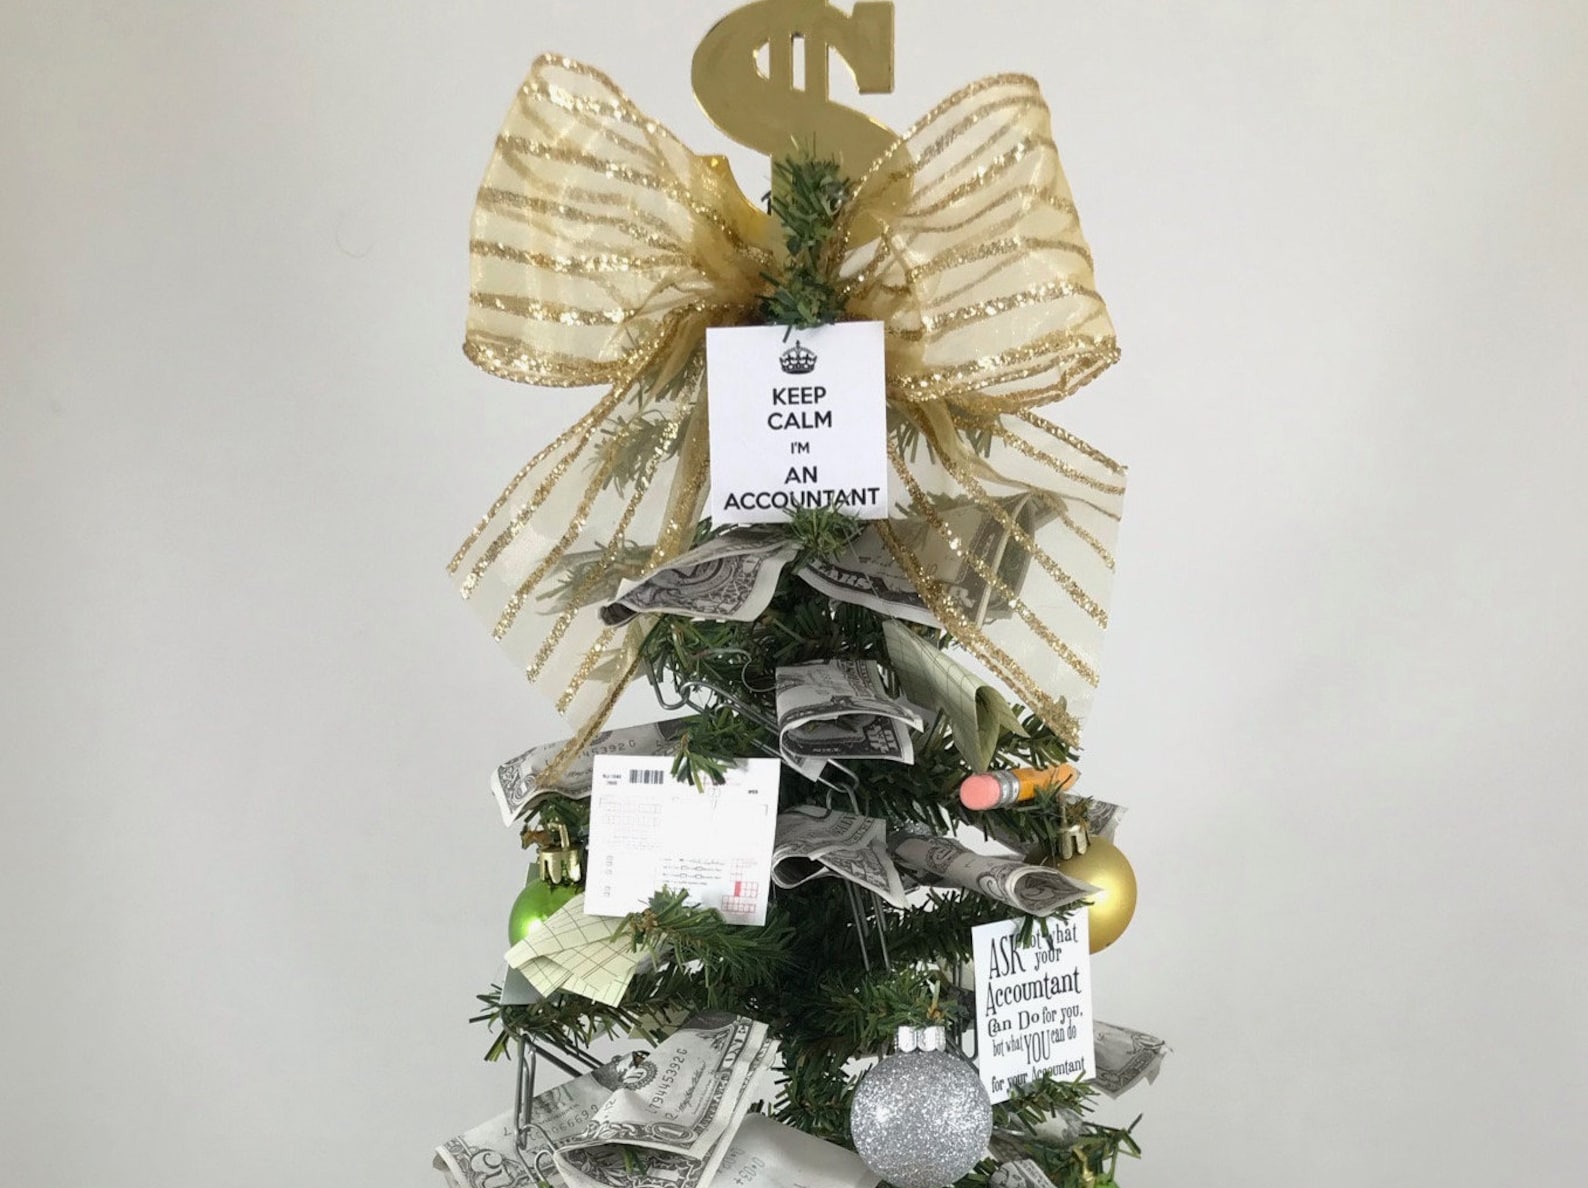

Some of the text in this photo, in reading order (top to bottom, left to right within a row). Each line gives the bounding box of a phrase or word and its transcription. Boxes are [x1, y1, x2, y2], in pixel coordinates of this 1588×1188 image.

[773, 386, 827, 405] KEEP
[768, 411, 832, 430] CALM
[791, 442, 810, 454] I'M
[784, 466, 818, 484] AN
[724, 488, 880, 511] ACCOUNTANT
[989, 933, 1026, 980] ASK
[985, 965, 1082, 1017] Accountant
[1018, 1010, 1040, 1031] Do
[1042, 1006, 1057, 1025] for
[1024, 1030, 1051, 1065] YOU
[1067, 1018, 1077, 1040] do
[991, 1076, 1005, 1093] for
